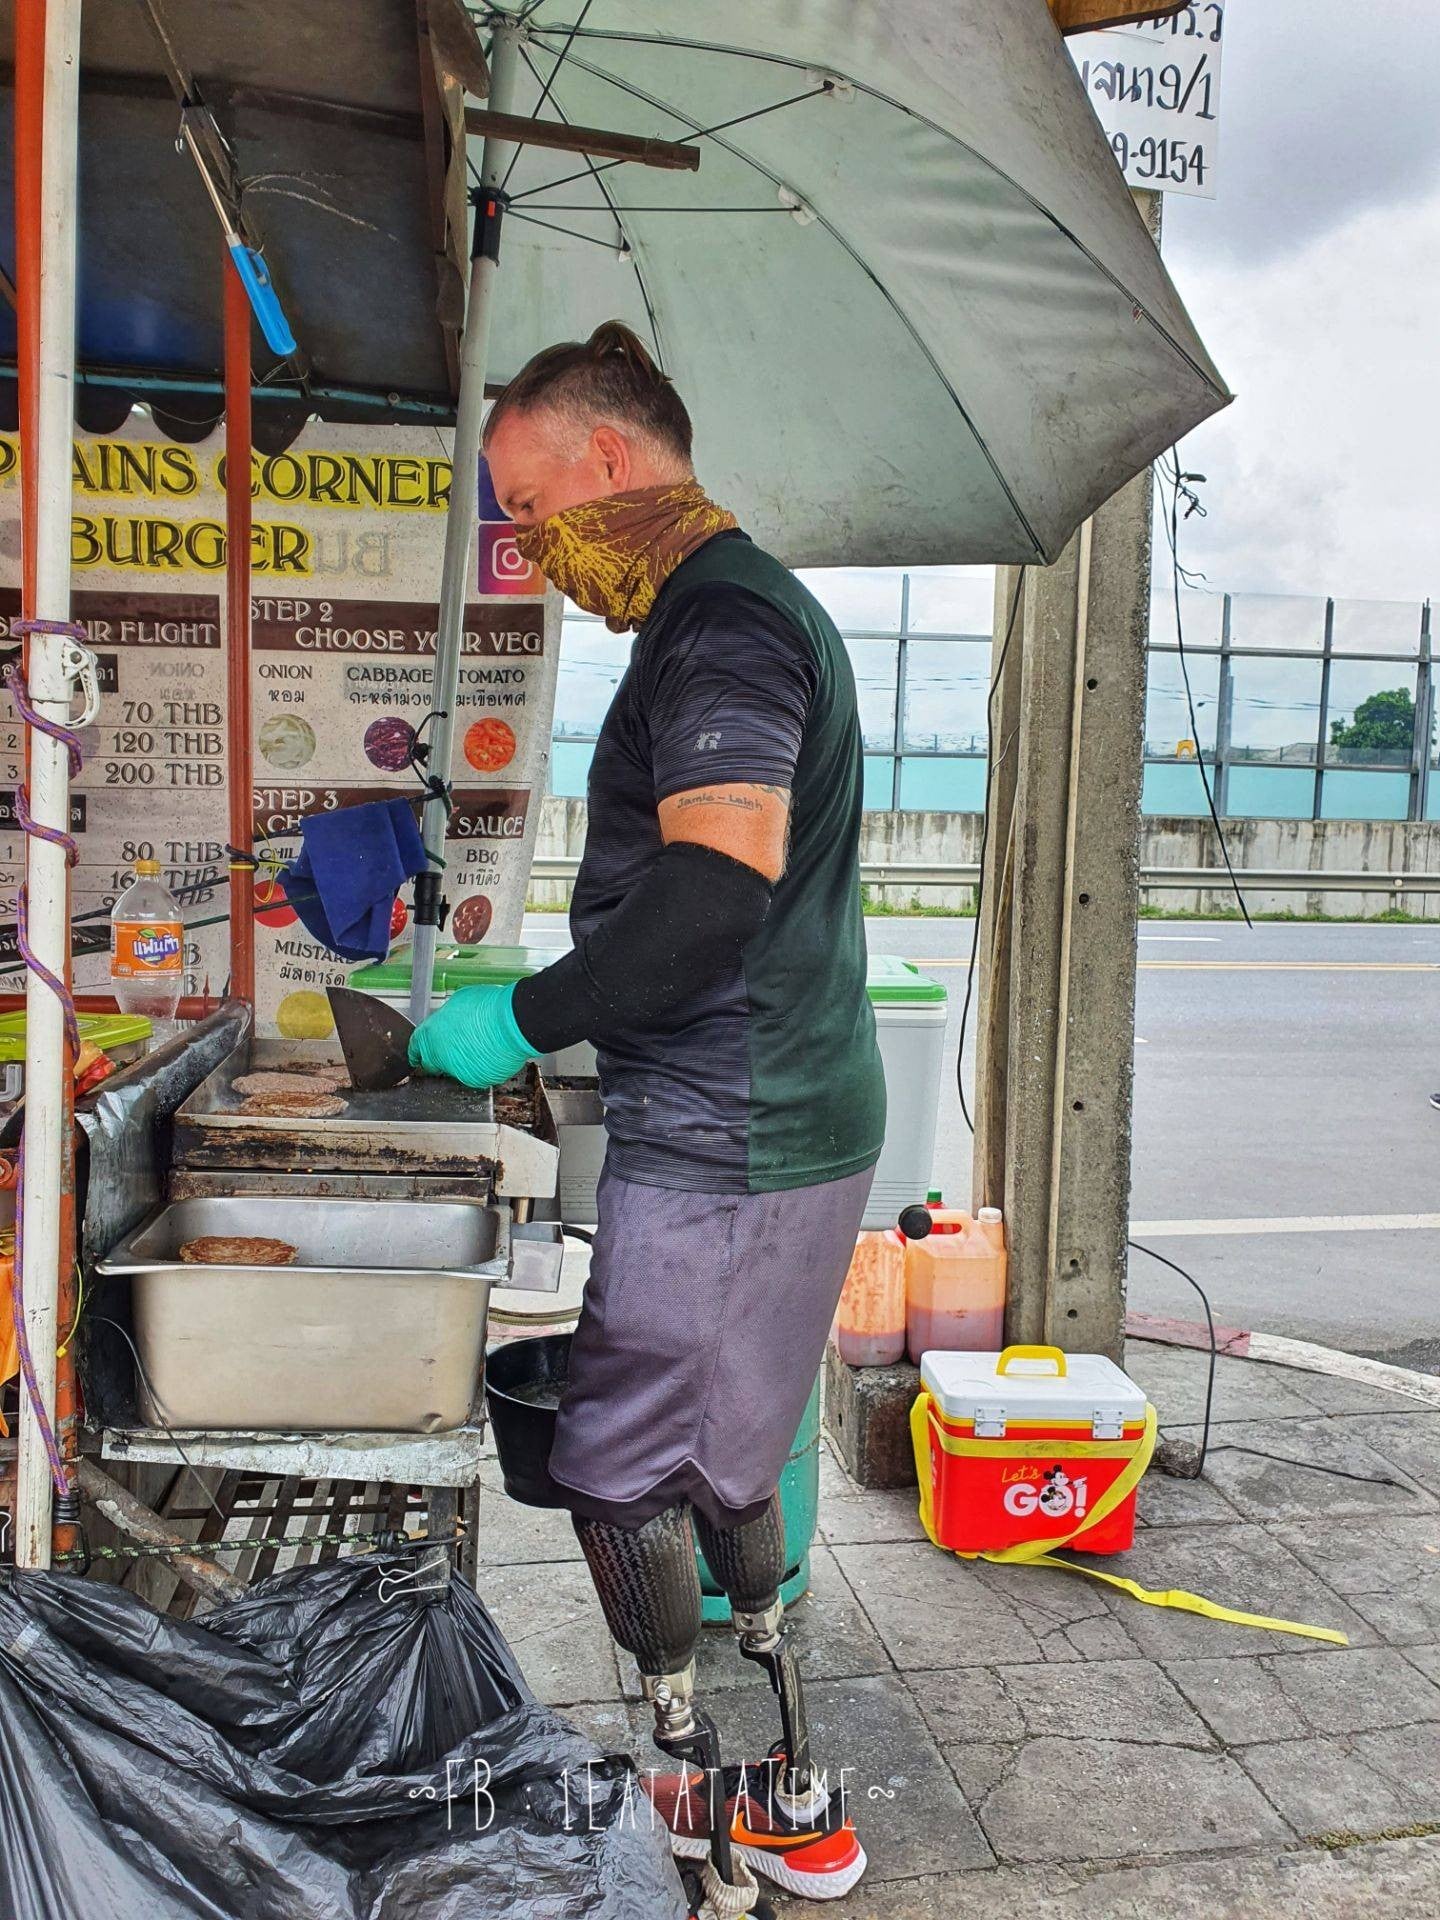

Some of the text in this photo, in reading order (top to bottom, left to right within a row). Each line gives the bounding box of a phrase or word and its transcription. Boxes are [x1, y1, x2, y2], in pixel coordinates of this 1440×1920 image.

[251, 600, 334, 622] STEP 2
[120, 620, 218, 646] FLIGHT
[295, 627, 406, 651] CHOOSE
[490, 631, 541, 653] VEG
[258, 664, 313, 680] ONION
[347, 667, 434, 684] CABBAGE
[458, 669, 525, 684] TOMATO
[268, 689, 305, 703] หอม
[122, 701, 155, 724] 70
[163, 702, 224, 726] THB
[7, 731, 224, 755] 2 120 THB
[7, 762, 224, 786] 3 200 THB
[253, 789, 339, 811] STEP 3
[457, 815, 523, 837] SAUCE
[121, 841, 155, 862] 80
[165, 841, 224, 863] THB
[466, 848, 499, 865] BBQ
[163, 865, 219, 890] THB
[274, 939, 354, 965] MUSTA
[1002, 1465, 1041, 1483] Let's
[1003, 1481, 1088, 1518] GO!
